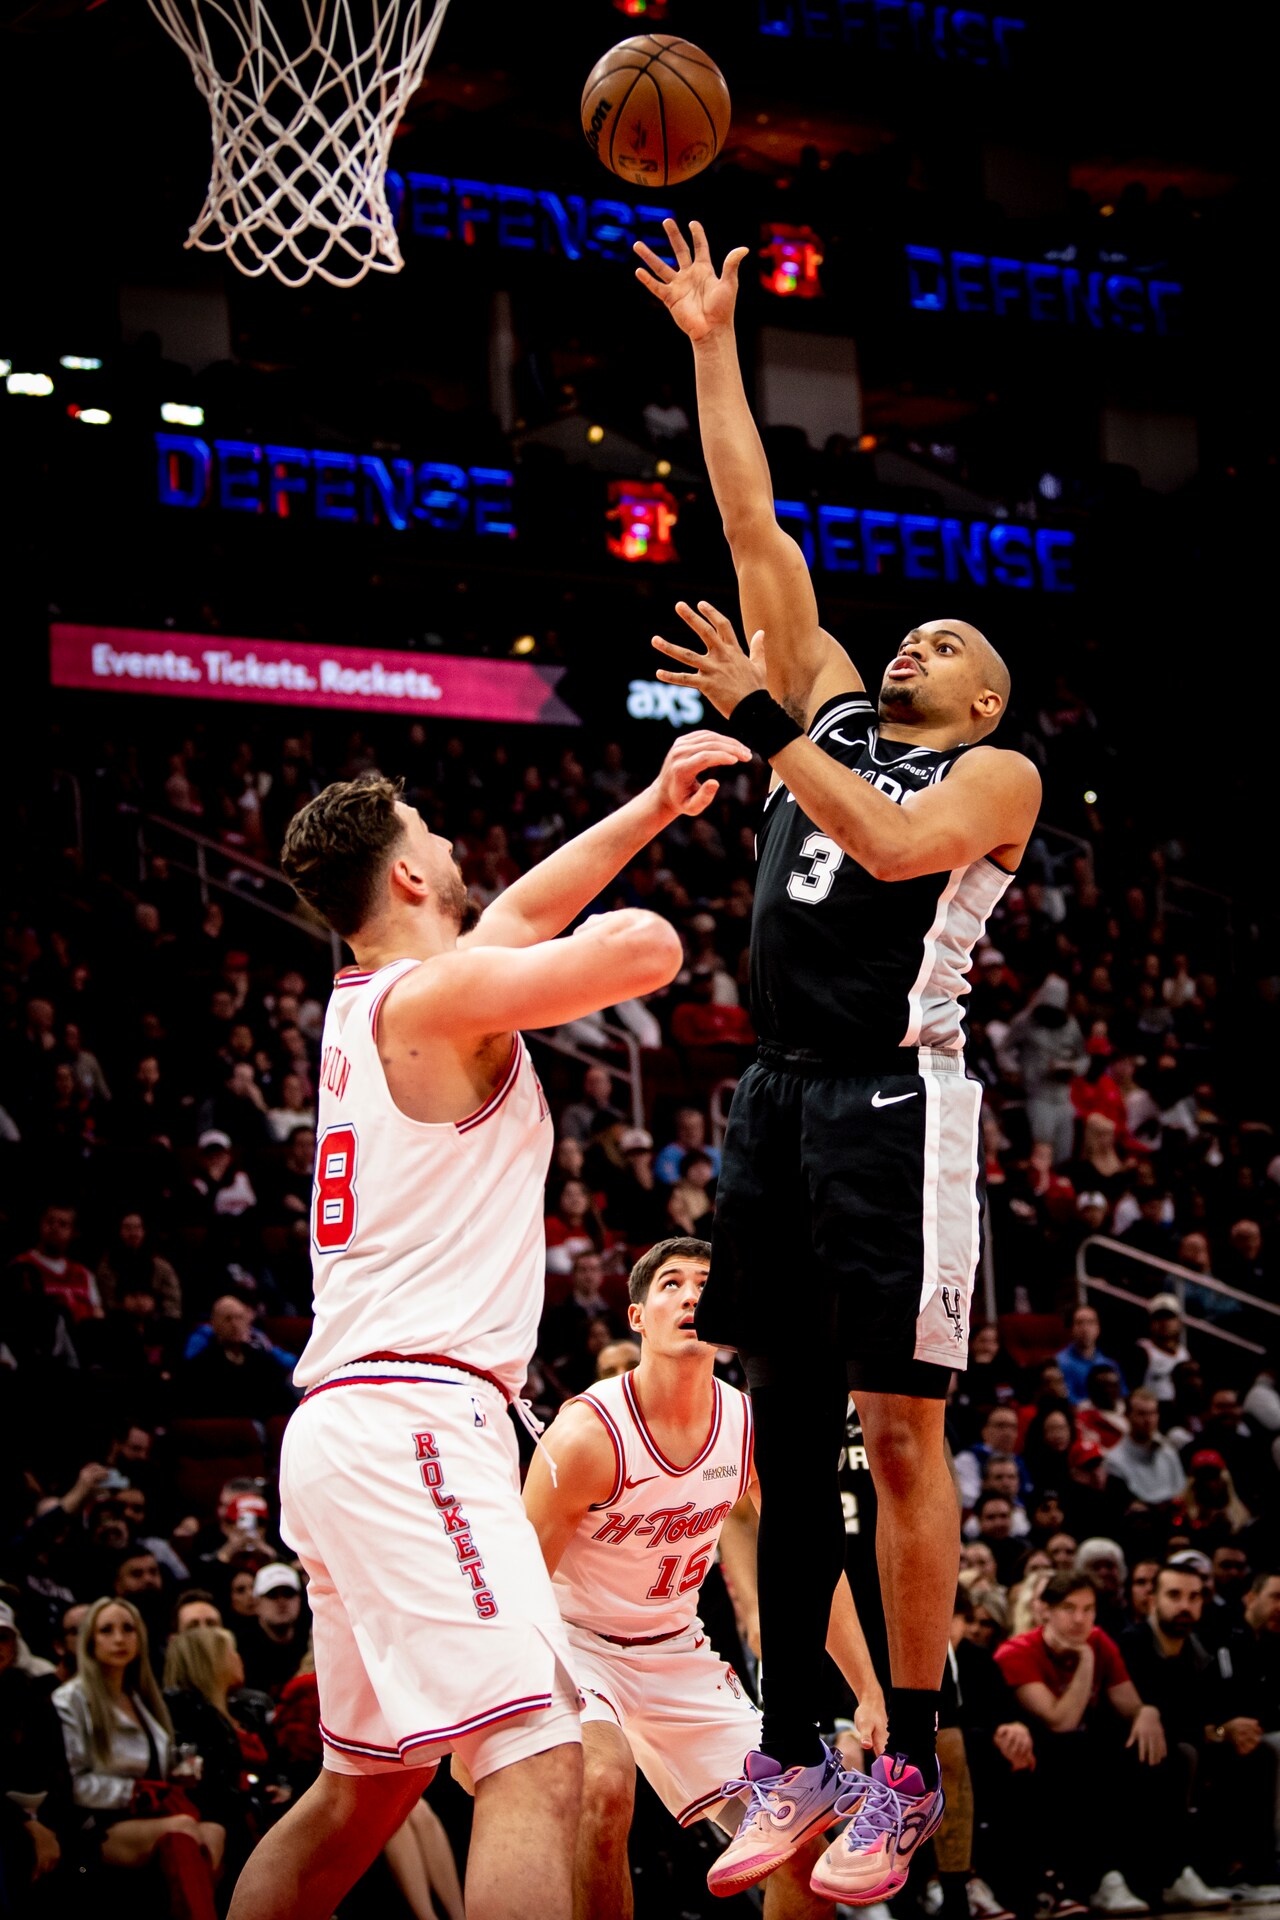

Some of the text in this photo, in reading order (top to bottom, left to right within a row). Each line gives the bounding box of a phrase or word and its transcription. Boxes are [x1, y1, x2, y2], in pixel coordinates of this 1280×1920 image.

[585, 99, 612, 148] son
[904, 243, 1185, 336] DEFENSE
[154, 431, 518, 540] DEFENSE
[91, 642, 443, 700] Events. Tickets. Rockets.
[626, 679, 704, 728] axs
[787, 831, 845, 905] 3
[312, 1122, 359, 1255] 8
[702, 1465, 737, 1476] MEMORIAL
[702, 1469, 738, 1481] HERMANN
[412, 1431, 499, 1620] ROCKETS
[591, 1501, 732, 1548] H-Town
[646, 1538, 717, 1600] 15
